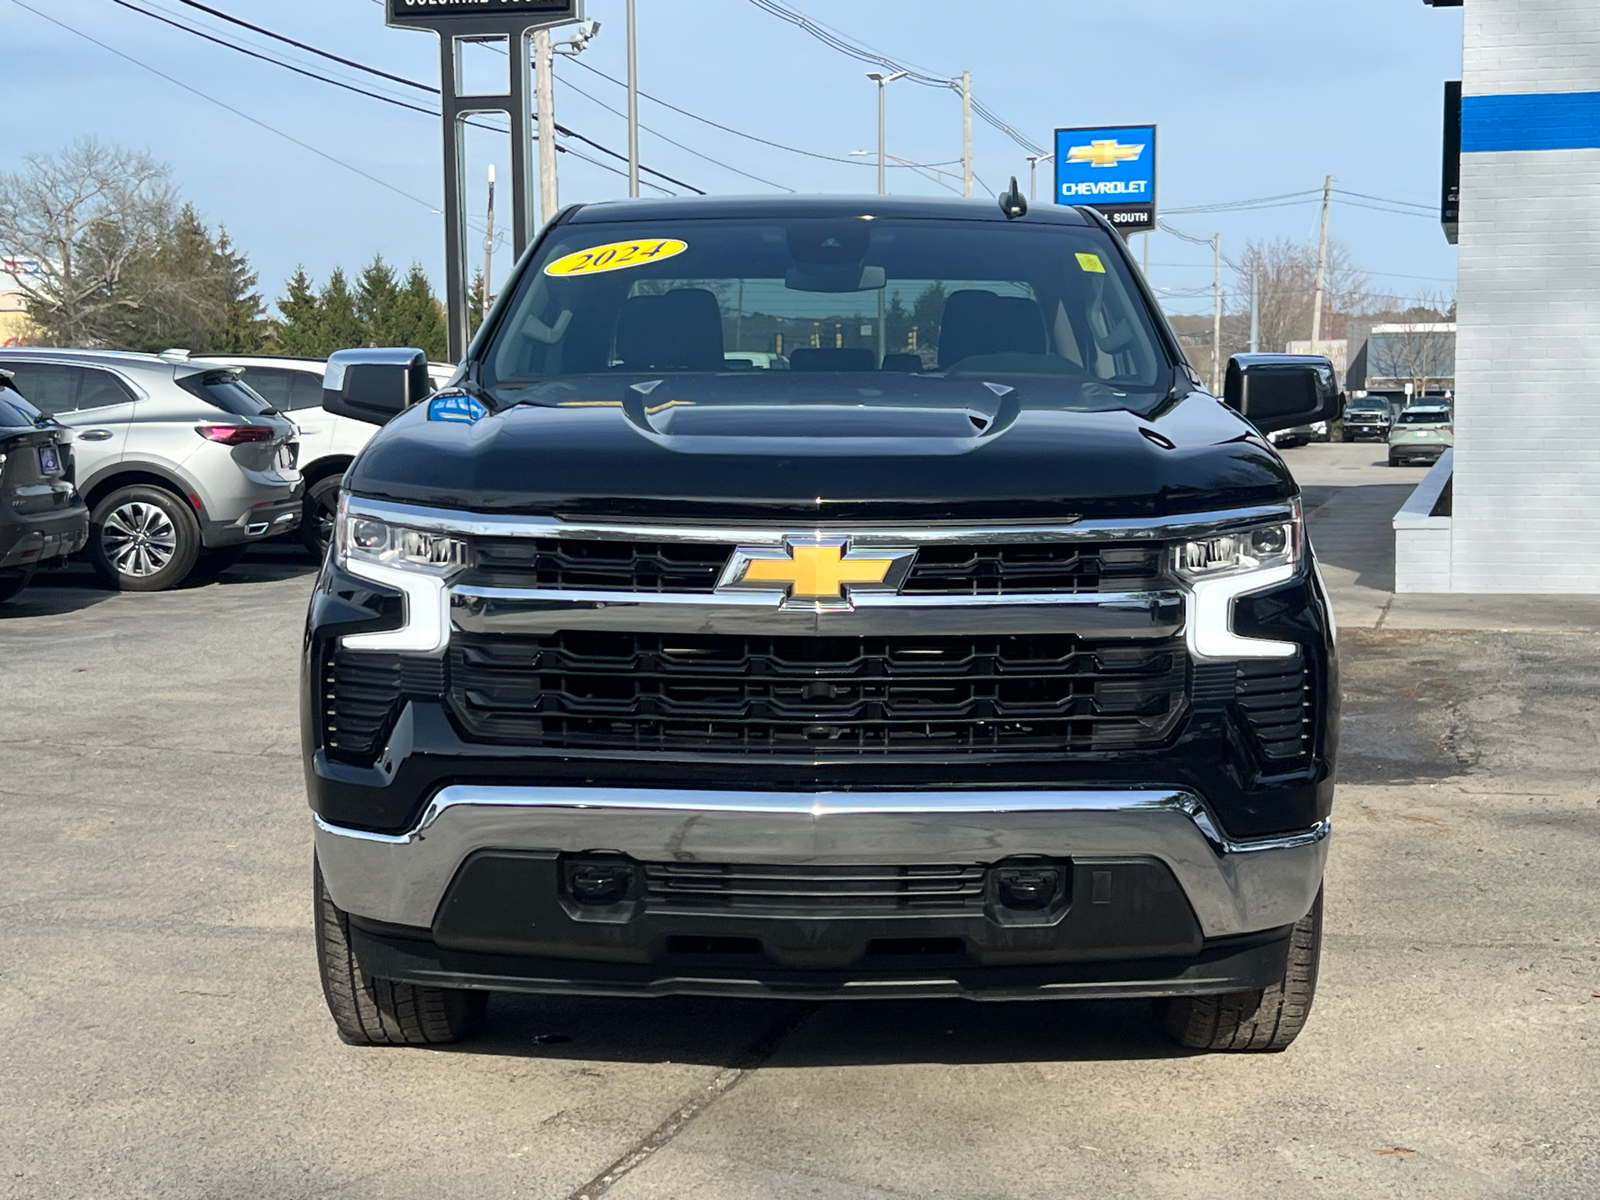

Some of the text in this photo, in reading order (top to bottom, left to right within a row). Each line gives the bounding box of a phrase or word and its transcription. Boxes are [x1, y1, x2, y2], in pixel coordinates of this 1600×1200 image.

[1062, 180, 1147, 195] CHEVROLET
[1113, 212, 1148, 223] SOUTH
[567, 240, 668, 272] 2024
